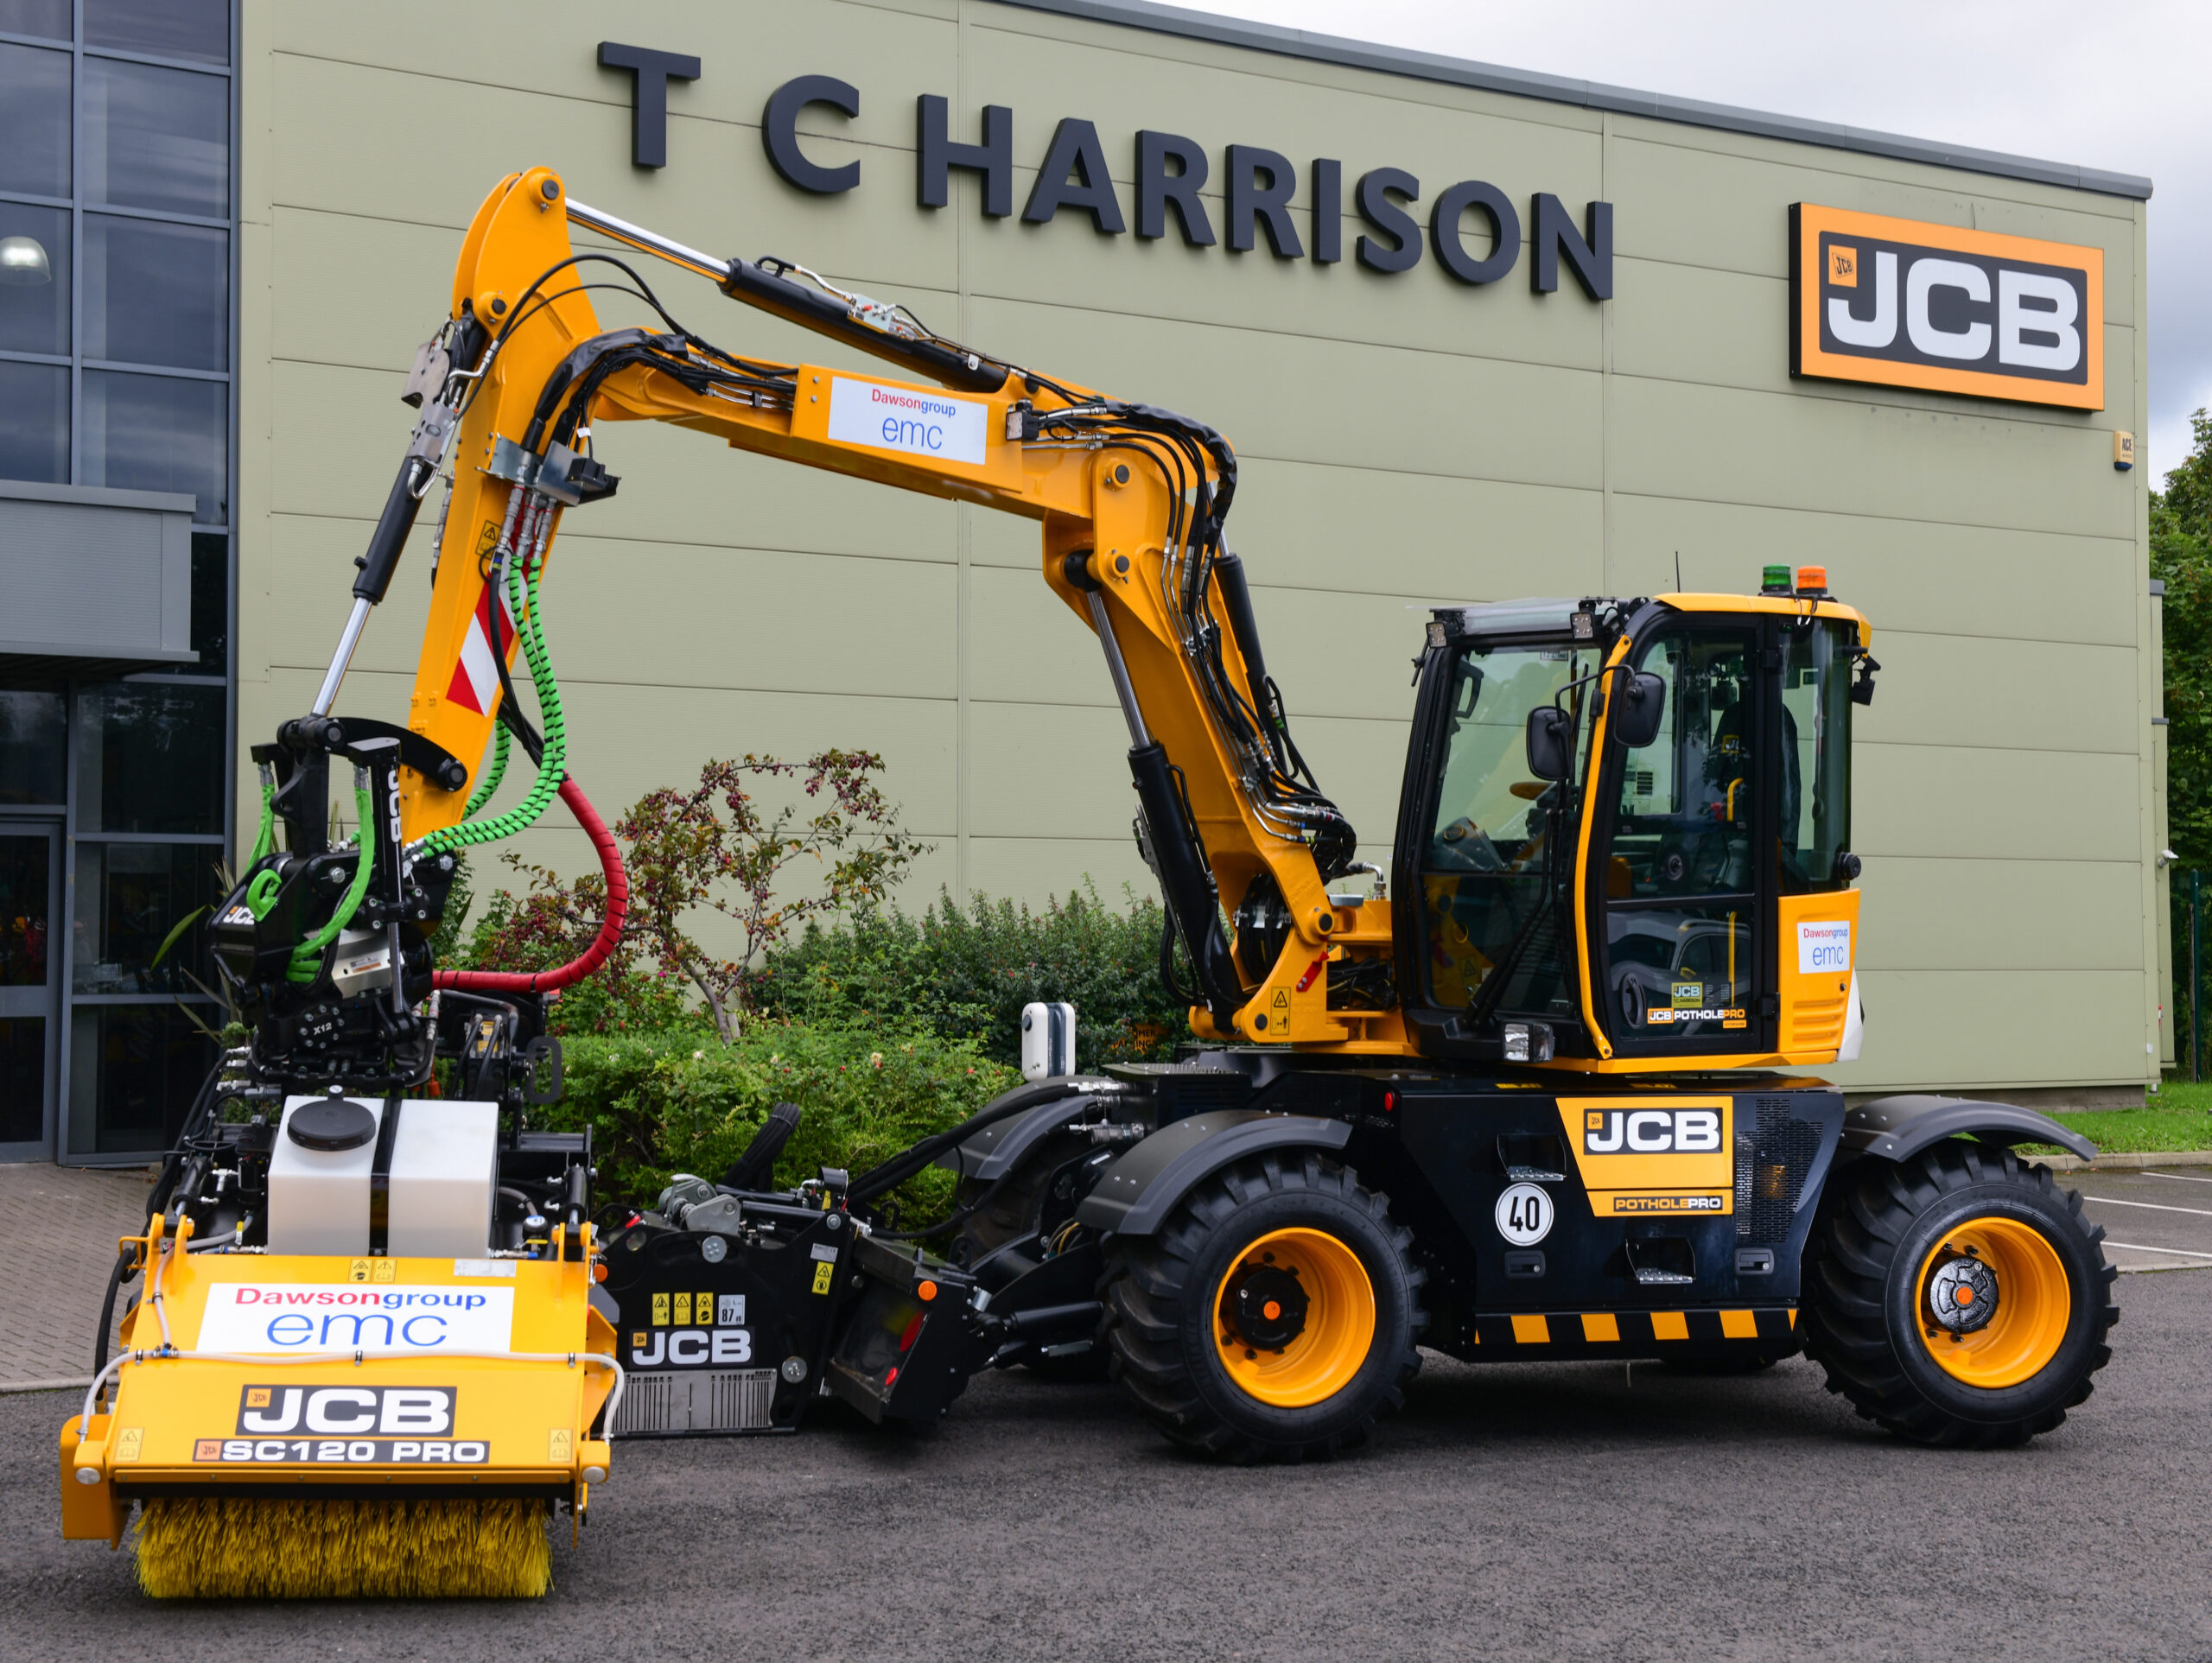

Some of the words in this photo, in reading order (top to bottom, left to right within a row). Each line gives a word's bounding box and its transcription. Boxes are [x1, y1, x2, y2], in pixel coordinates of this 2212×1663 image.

[597, 41, 701, 169] T
[762, 73, 861, 194] C
[917, 92, 1613, 301] HARRISON
[1835, 255, 1853, 276] JCB
[1828, 250, 2081, 371] JCB
[871, 388, 957, 418] Dawsongroup
[882, 417, 943, 450] emc
[1803, 928, 1848, 940] Dawsongroup
[1812, 946, 1844, 966] emc
[1675, 986, 1700, 997] JCB
[1649, 1011, 1672, 1021] JCB
[314, 1022, 332, 1035] X12
[1586, 1111, 1719, 1152] JCB
[1509, 1196, 1540, 1232] 40
[1615, 1198, 1721, 1209] POTHOLEPRO
[235, 1288, 486, 1311] Dawsongroup
[721, 1308, 734, 1323] 87
[266, 1314, 448, 1347] emc
[632, 1330, 751, 1366] JCB
[243, 1388, 449, 1433] JCB
[222, 1440, 376, 1462] SC120
[392, 1441, 486, 1462] PRO
